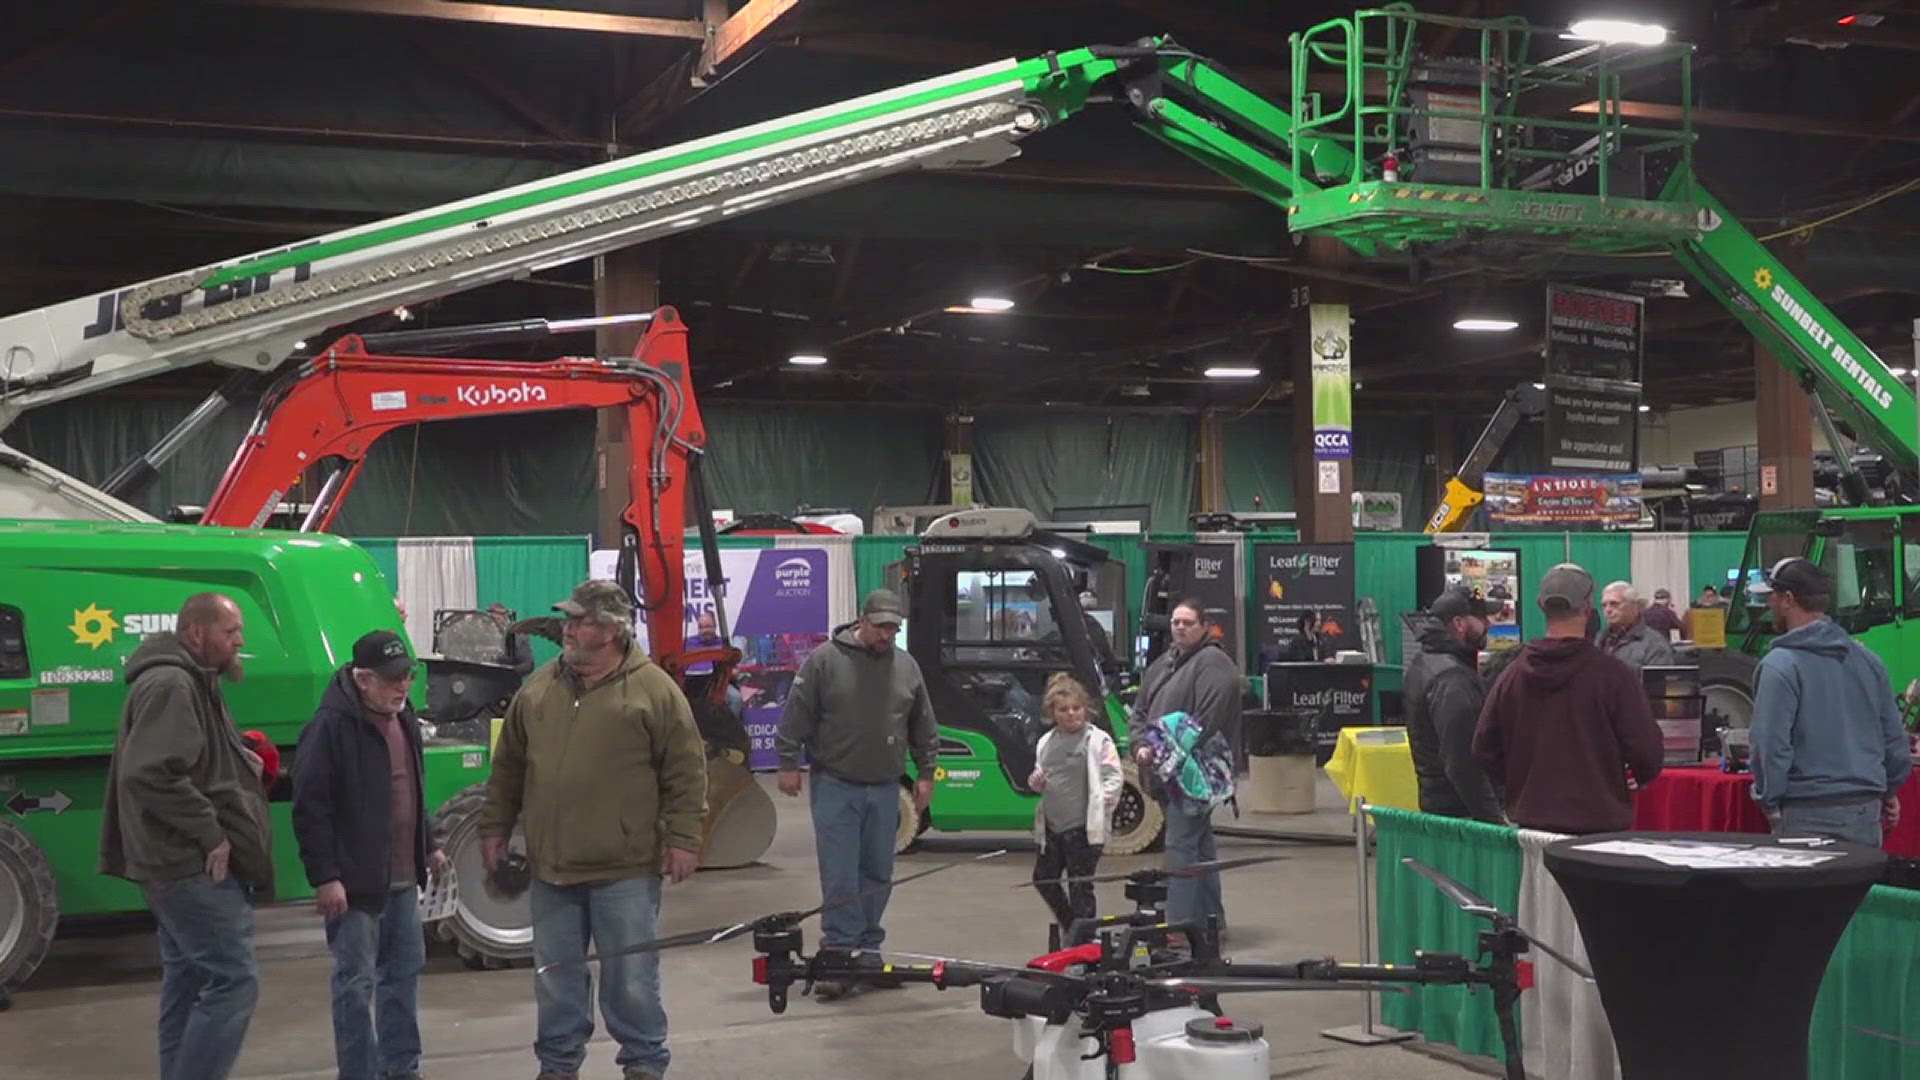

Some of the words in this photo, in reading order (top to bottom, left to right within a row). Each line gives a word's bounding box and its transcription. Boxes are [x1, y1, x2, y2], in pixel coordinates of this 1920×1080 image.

[1771, 284, 1834, 350] SUNBELT
[1831, 344, 1893, 409] RENTALS
[457, 382, 547, 406] Kubota
[1315, 434, 1349, 447] QCCA
[1430, 504, 1450, 529] JCB
[1195, 559, 1223, 571] Filter
[775, 566, 810, 580] purple
[782, 579, 810, 587] wave
